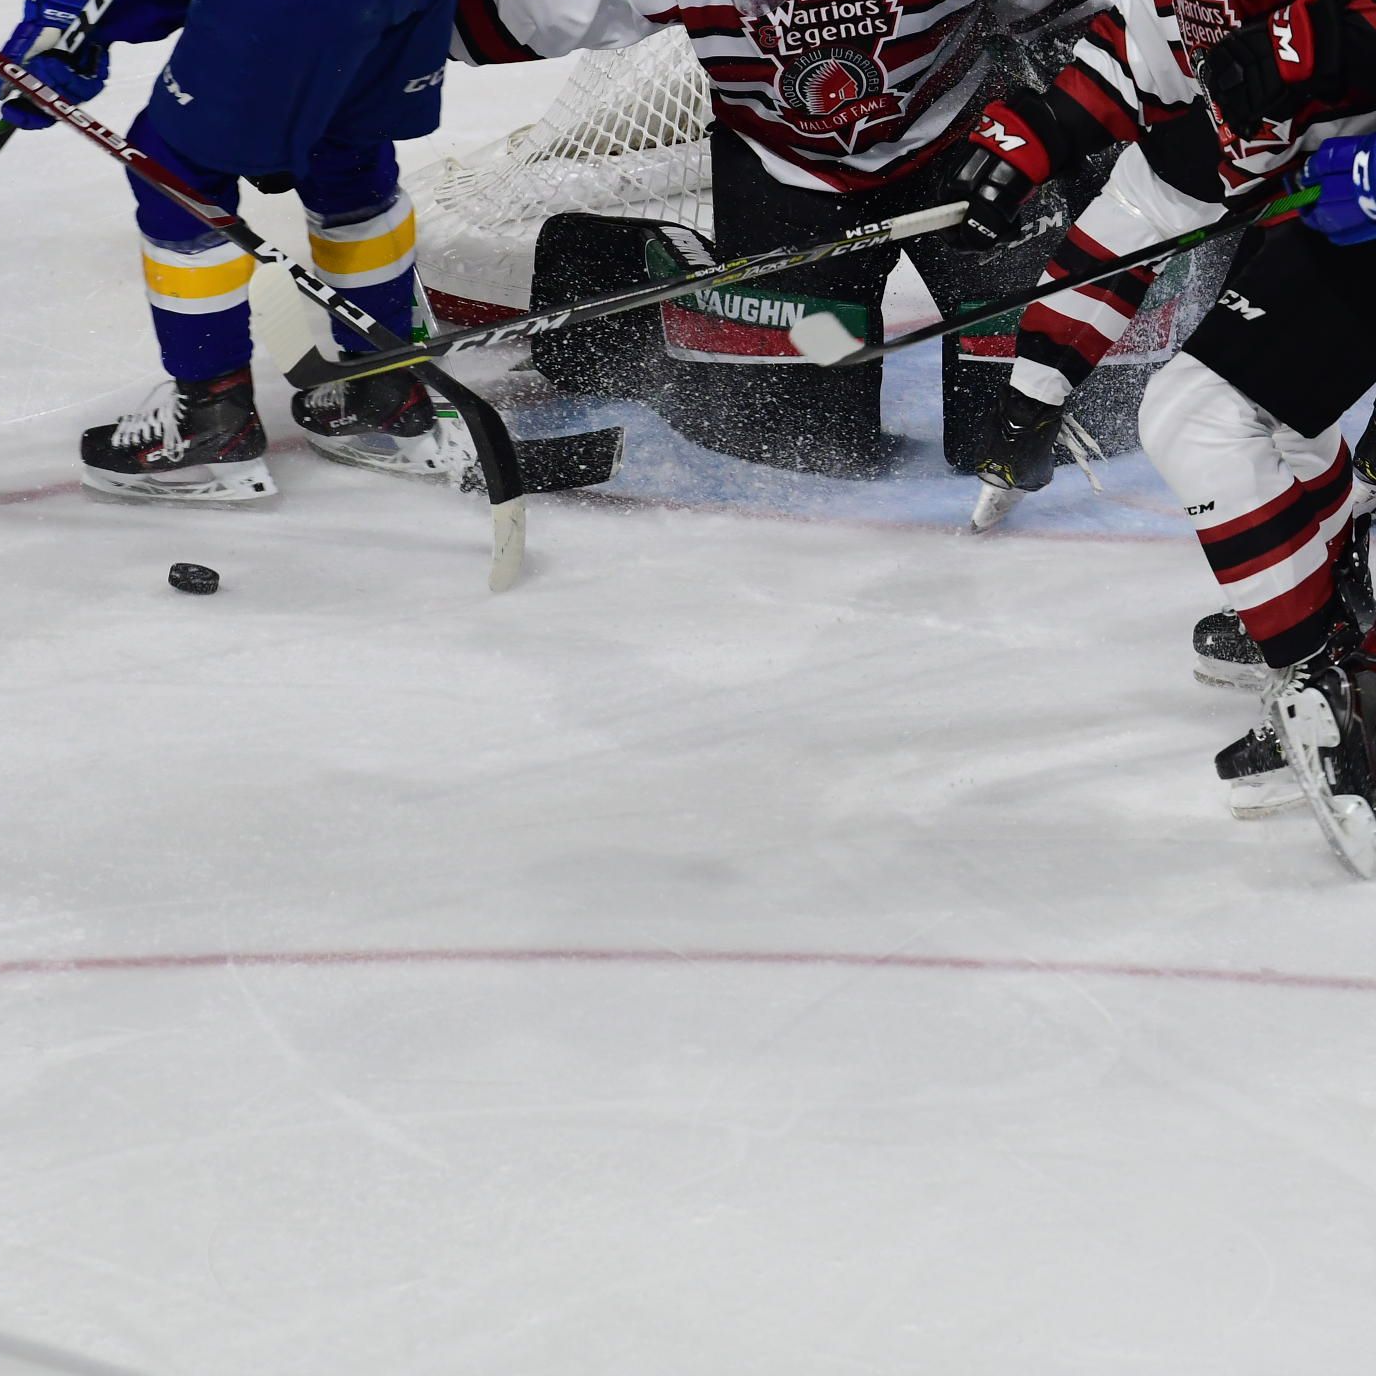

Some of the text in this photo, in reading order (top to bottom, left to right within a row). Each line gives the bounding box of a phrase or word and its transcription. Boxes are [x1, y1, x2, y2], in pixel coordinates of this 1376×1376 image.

[766, 0, 880, 28] Warriors
[775, 17, 888, 56] Legends
[830, 47, 880, 92] WARRIORS
[799, 96, 888, 132] HALL OF FAME
[695, 288, 806, 329] VAUGHN
[1184, 500, 1215, 516] CM
